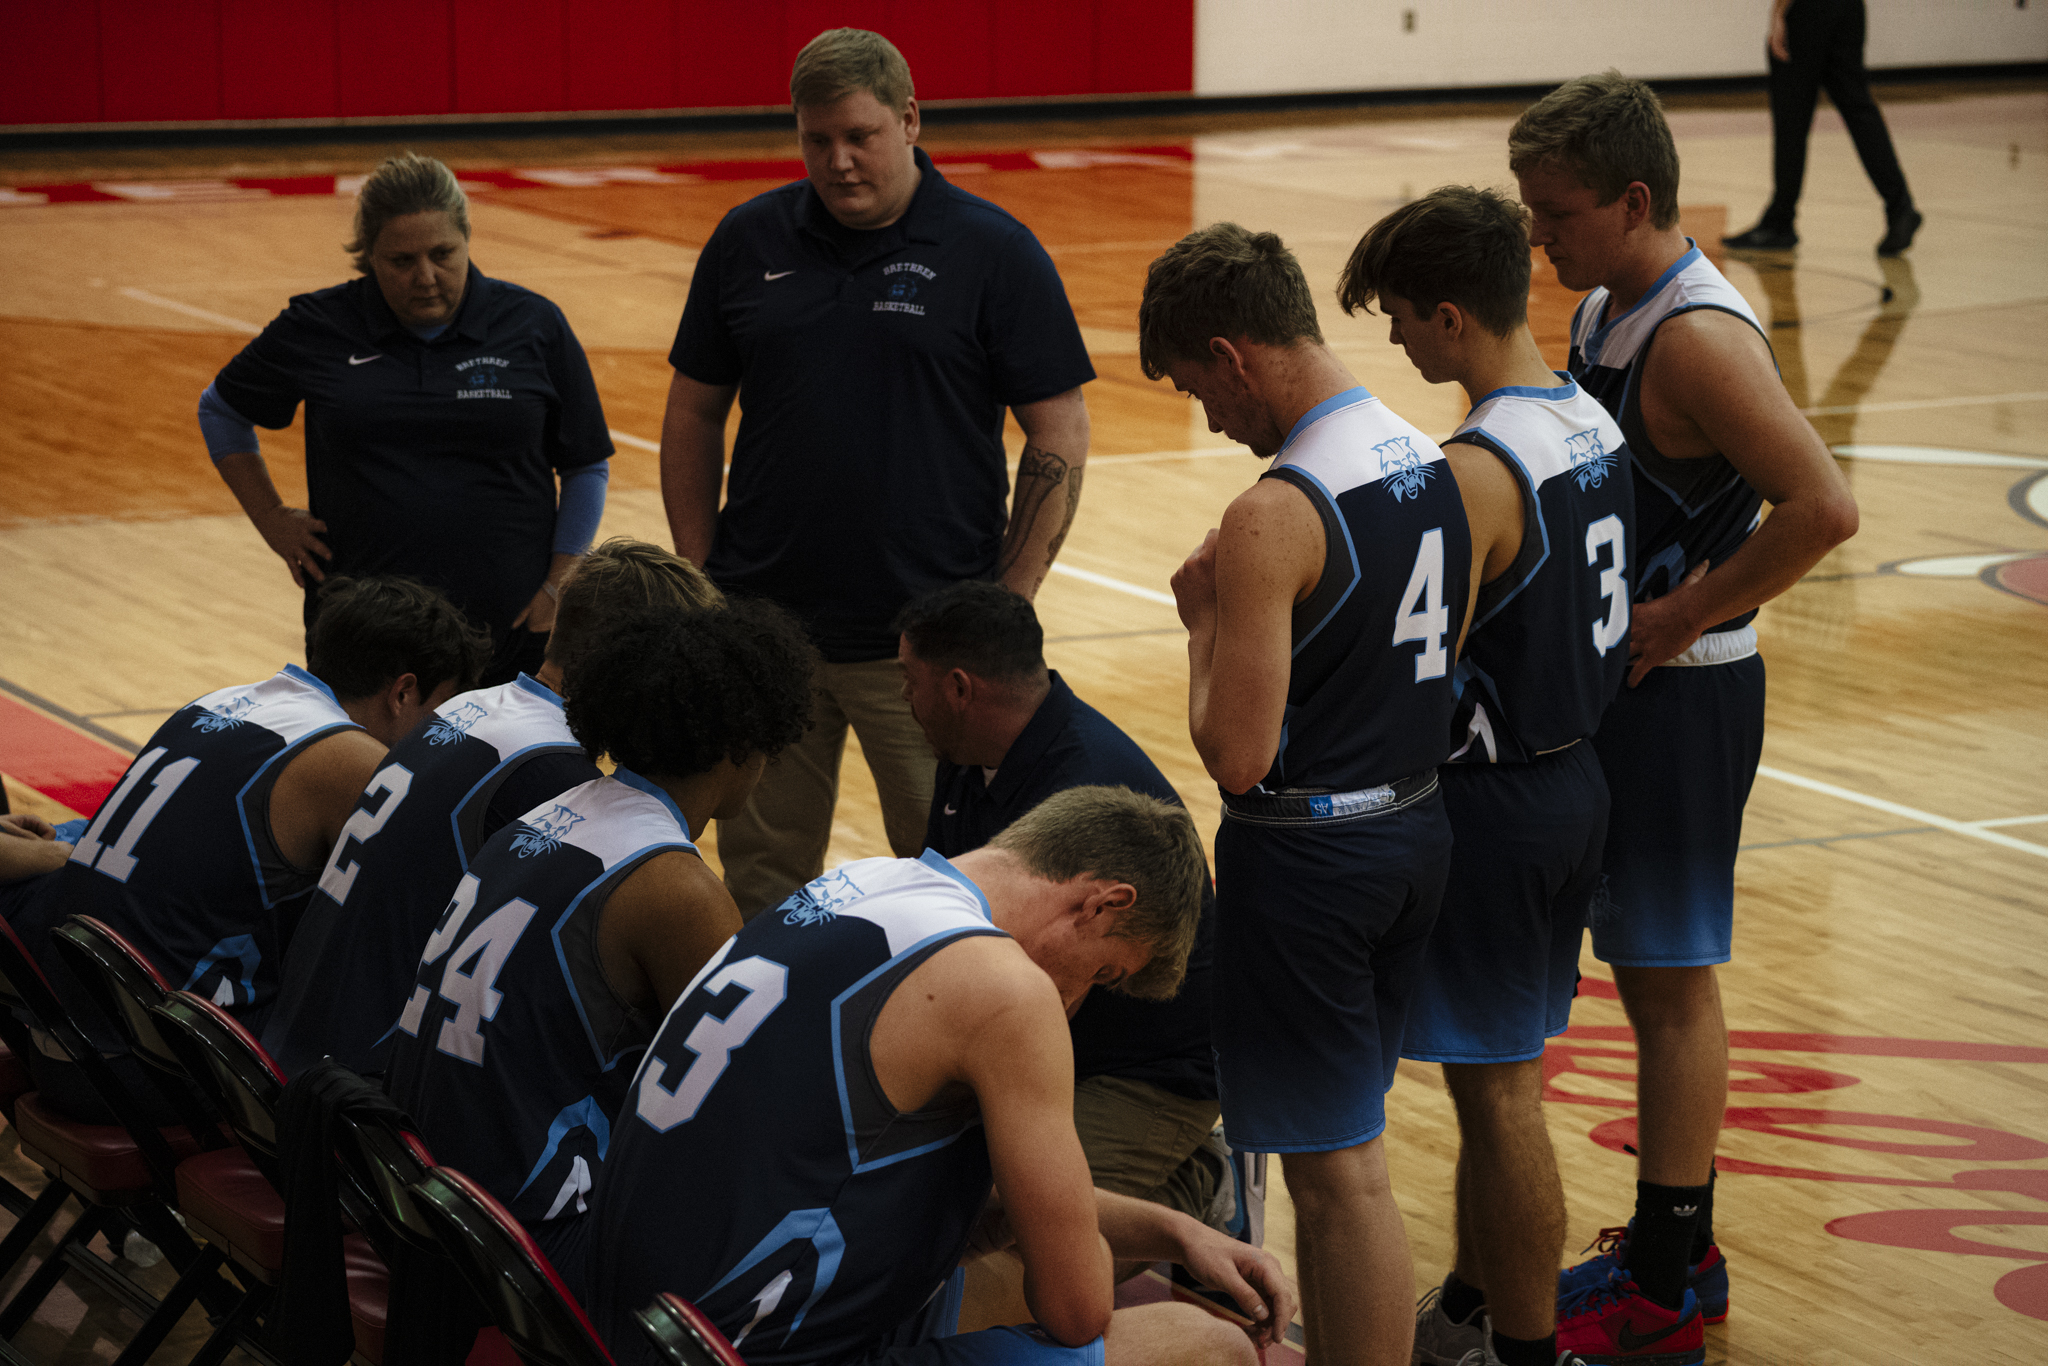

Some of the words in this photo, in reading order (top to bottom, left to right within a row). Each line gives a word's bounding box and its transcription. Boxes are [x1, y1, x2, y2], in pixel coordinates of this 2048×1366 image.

[873, 301, 925, 316] BASKETBALL
[456, 389, 512, 399] BASKETBALL
[1392, 527, 1449, 684] 4
[1585, 513, 1629, 658] 3
[68, 746, 201, 883] 11
[317, 762, 414, 906] 2
[398, 871, 539, 1067] 24
[629, 934, 789, 1134] 3
